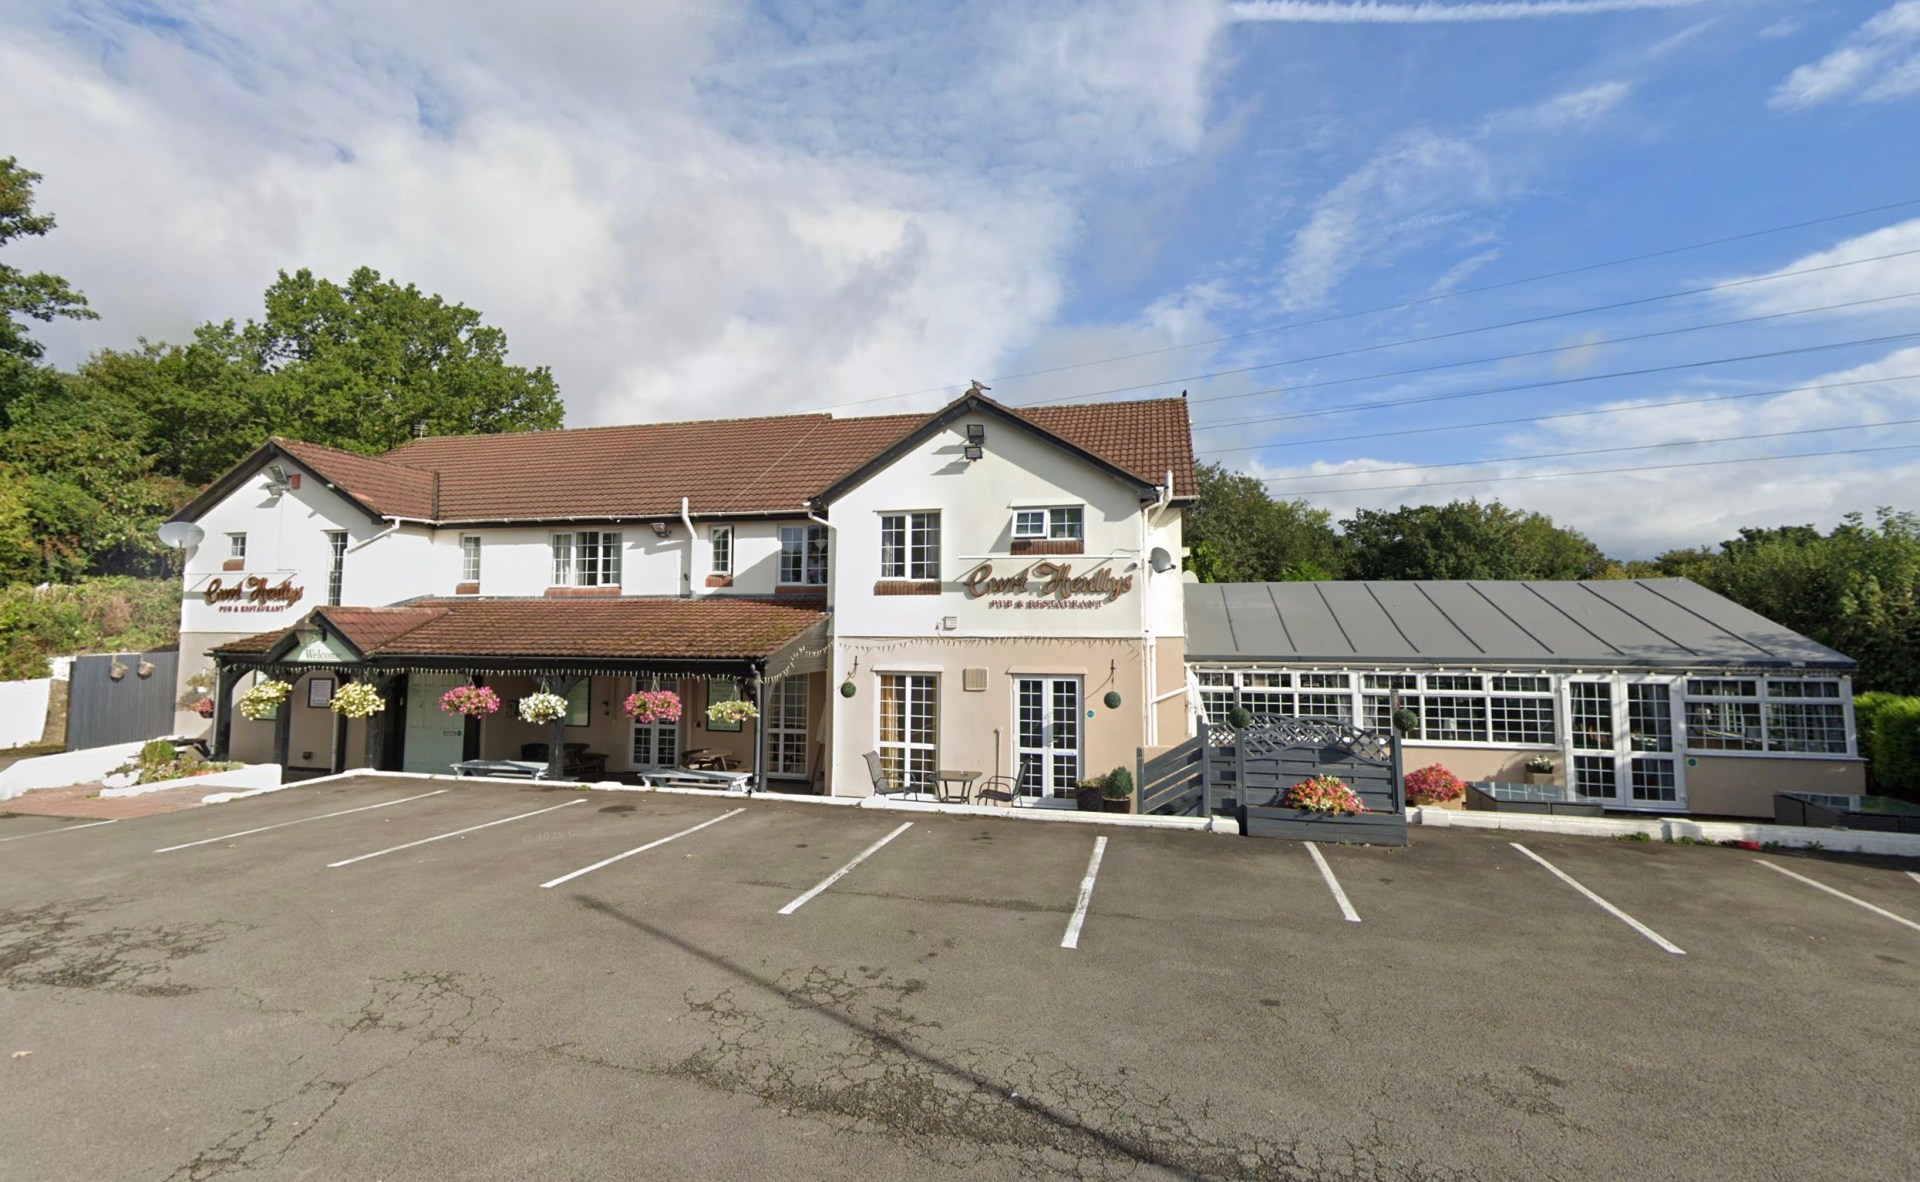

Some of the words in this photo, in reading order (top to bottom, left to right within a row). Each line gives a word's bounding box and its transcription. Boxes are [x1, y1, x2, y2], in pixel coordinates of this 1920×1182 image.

[963, 563, 1029, 597] Cwrt
[991, 600, 1012, 609] PUB
[1015, 600, 1025, 609] &
[1028, 600, 1102, 609] RESTAURANT
[305, 649, 343, 660] Welcome
